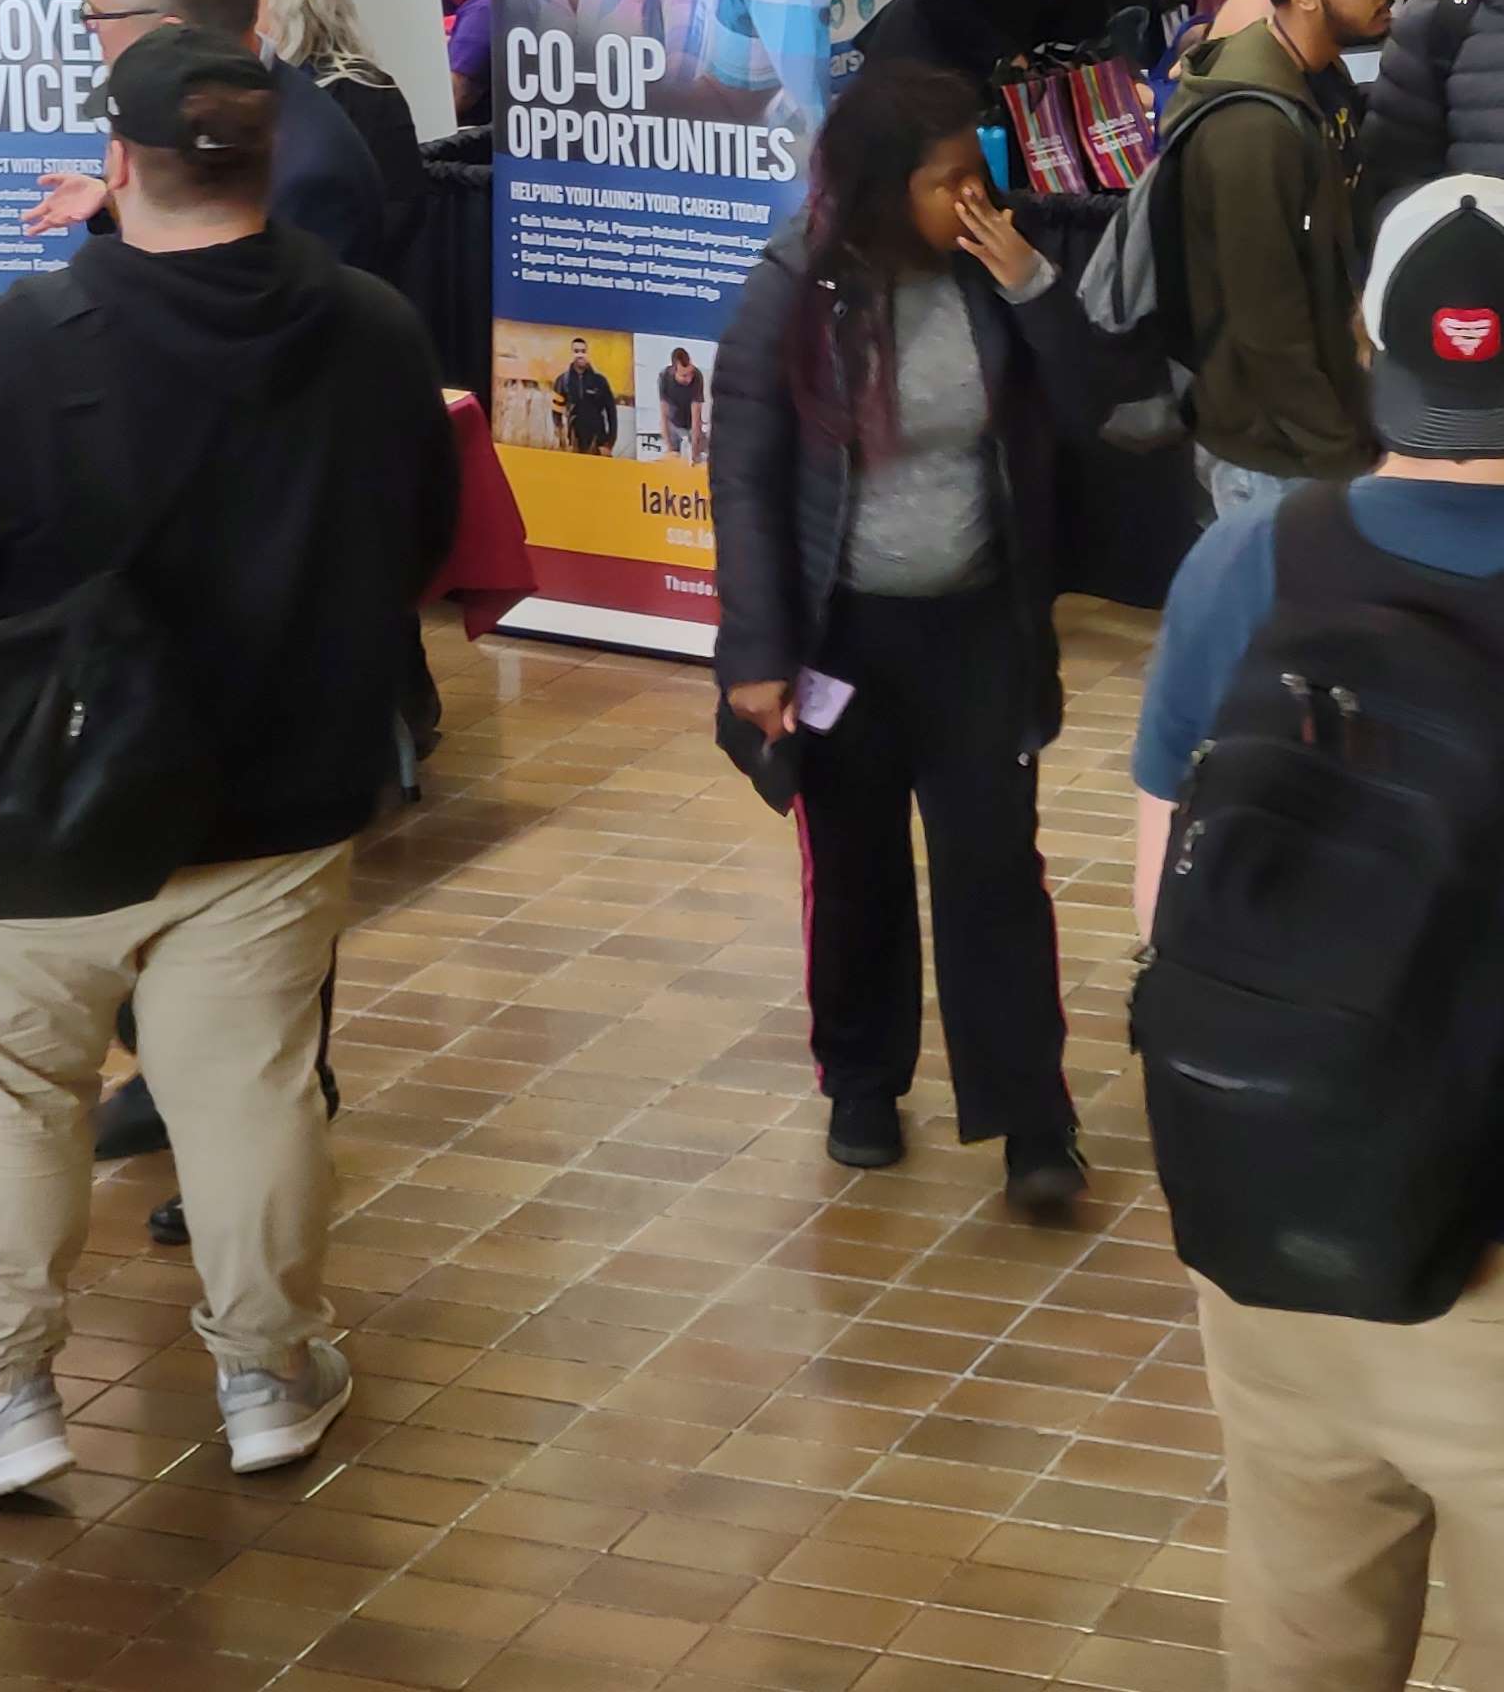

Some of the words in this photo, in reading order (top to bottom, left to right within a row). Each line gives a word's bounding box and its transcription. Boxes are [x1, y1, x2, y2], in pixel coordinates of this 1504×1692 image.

[506, 26, 667, 111] CO-OP
[507, 104, 798, 183] OPPORTUNITIES
[10, 158, 42, 174] WITH
[43, 158, 103, 175] STUDENTS
[510, 180, 565, 205] HELPING
[564, 186, 593, 207] YOU
[593, 188, 645, 211] LAUNCH
[645, 192, 681, 214] YOUR
[682, 196, 731, 221] CAREER
[731, 201, 772, 225] TODAY
[640, 483, 714, 522] lakeh
[664, 574, 718, 598] Thunde
